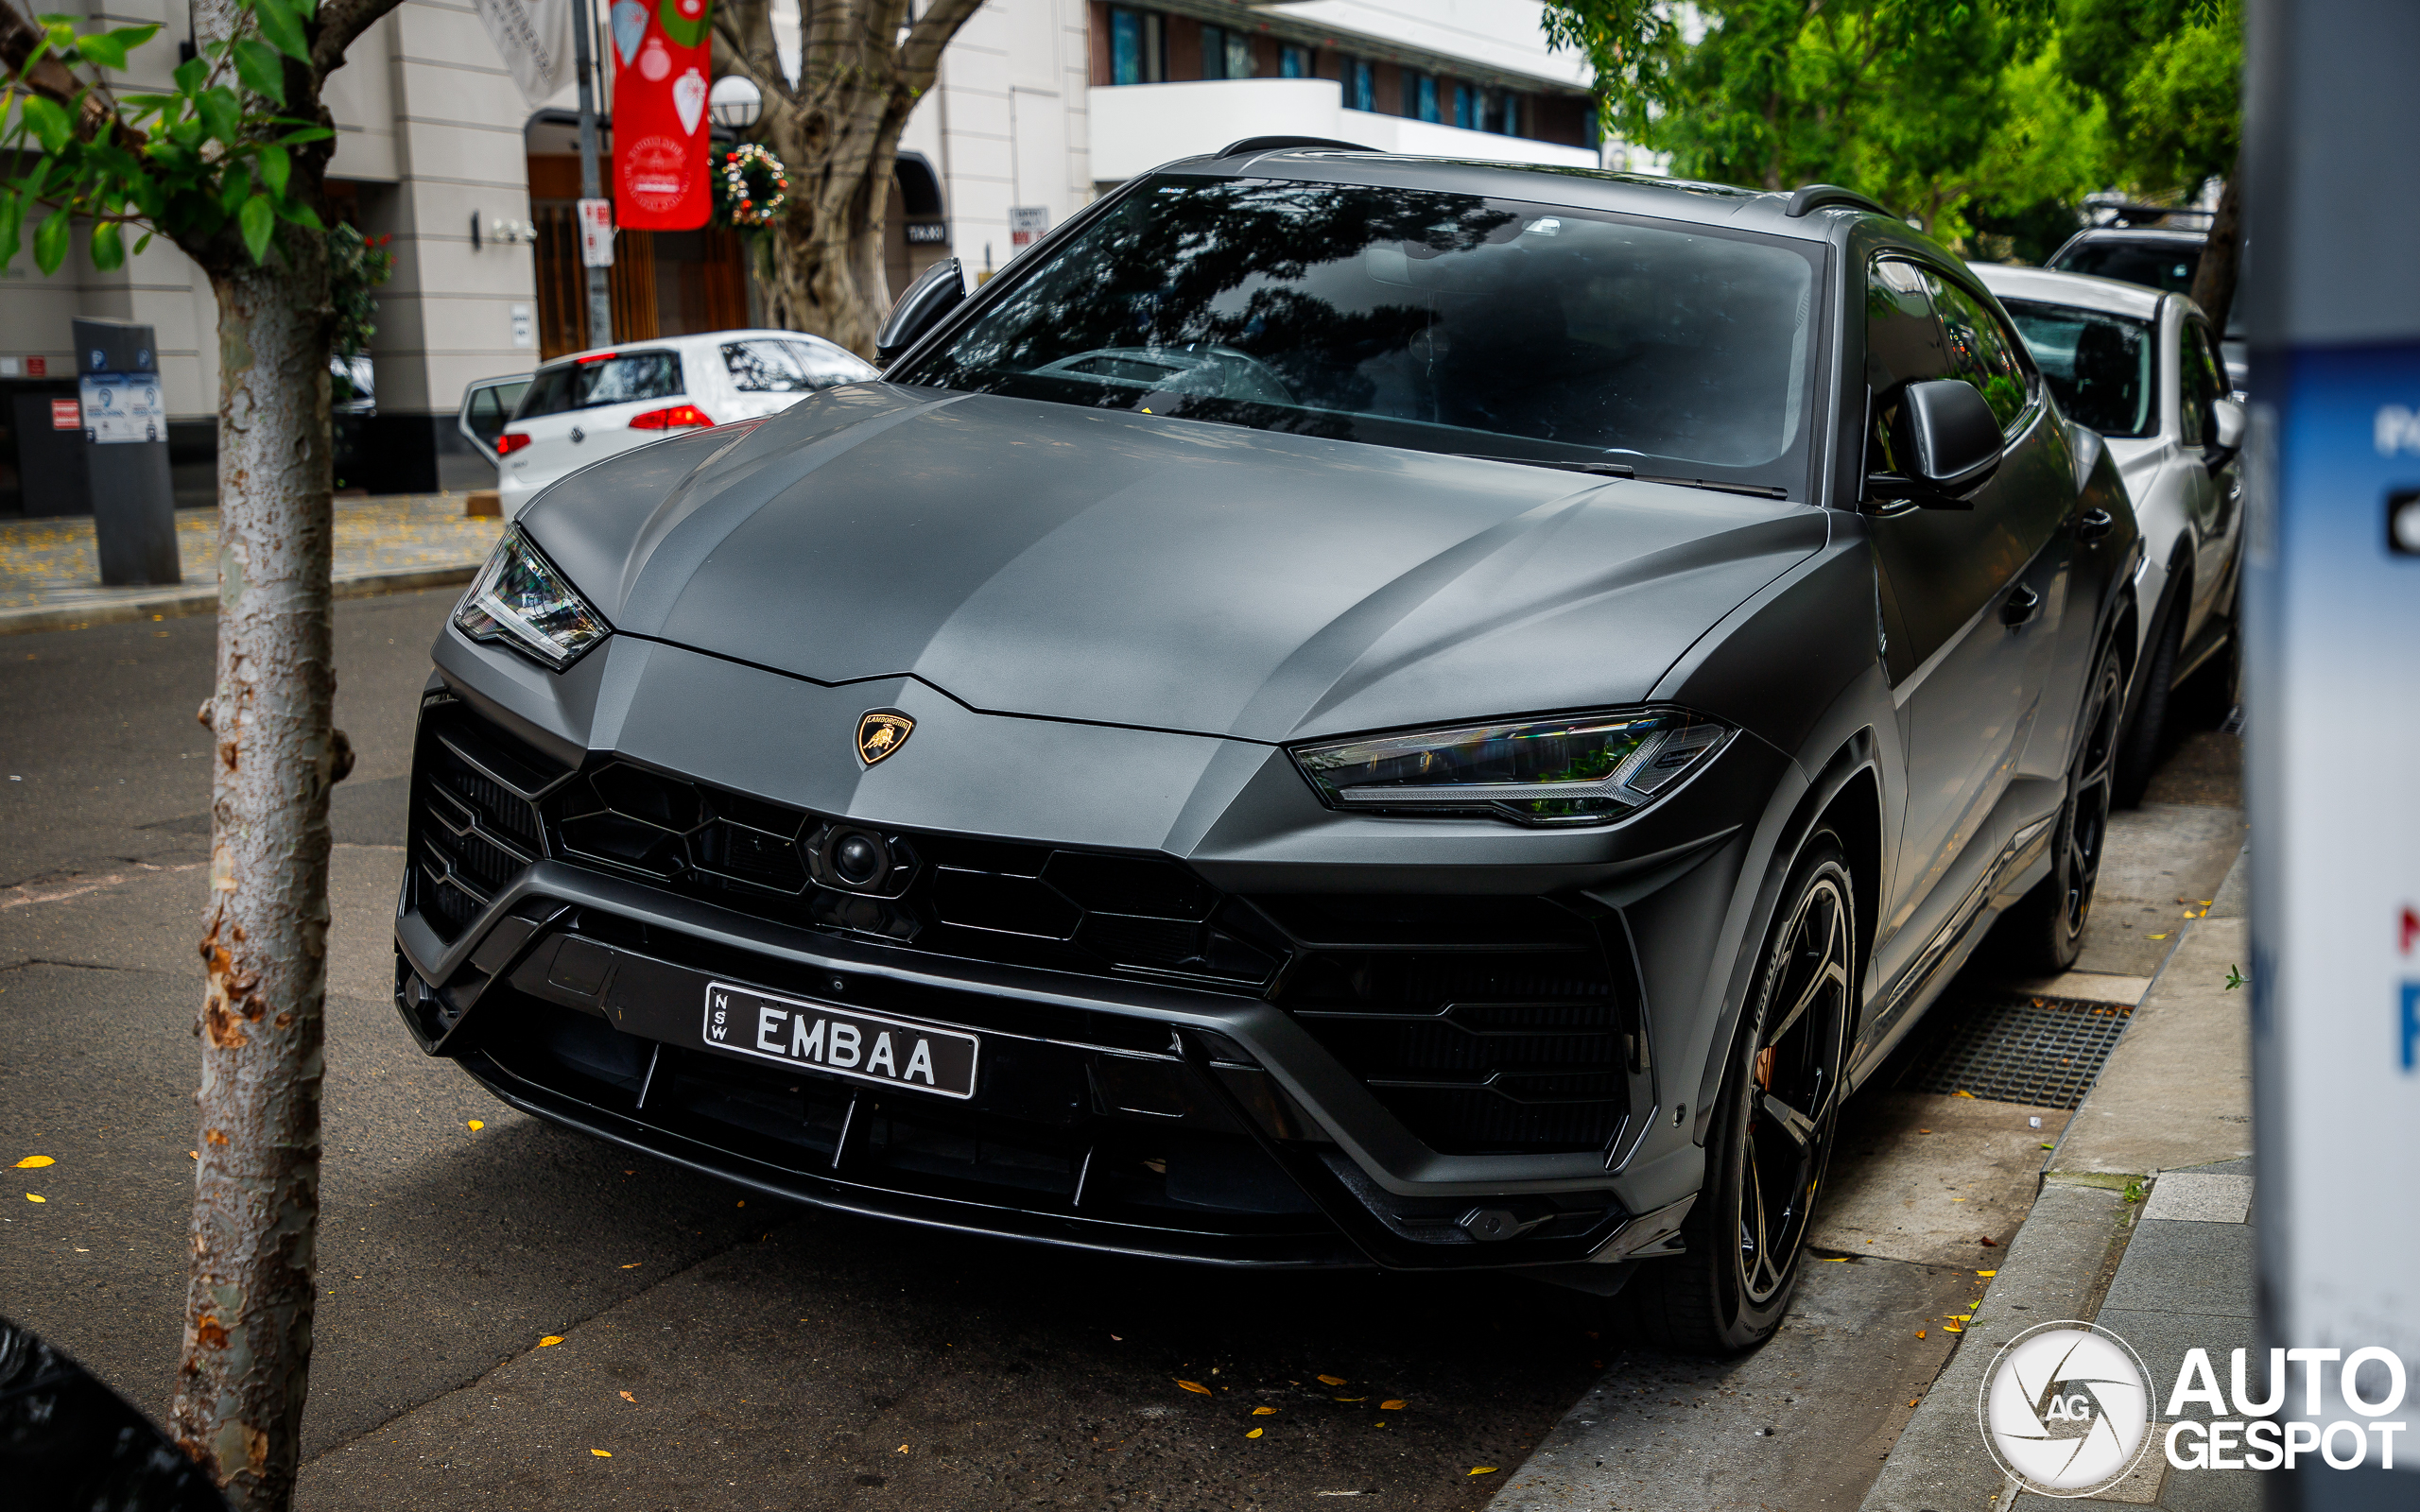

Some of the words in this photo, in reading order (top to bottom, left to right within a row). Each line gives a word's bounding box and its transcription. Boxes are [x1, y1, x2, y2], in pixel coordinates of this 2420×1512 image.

[908, 225, 944, 242] TAXI
[867, 716, 909, 730] LAMBORGHINI
[757, 1006, 935, 1085] EMBAA
